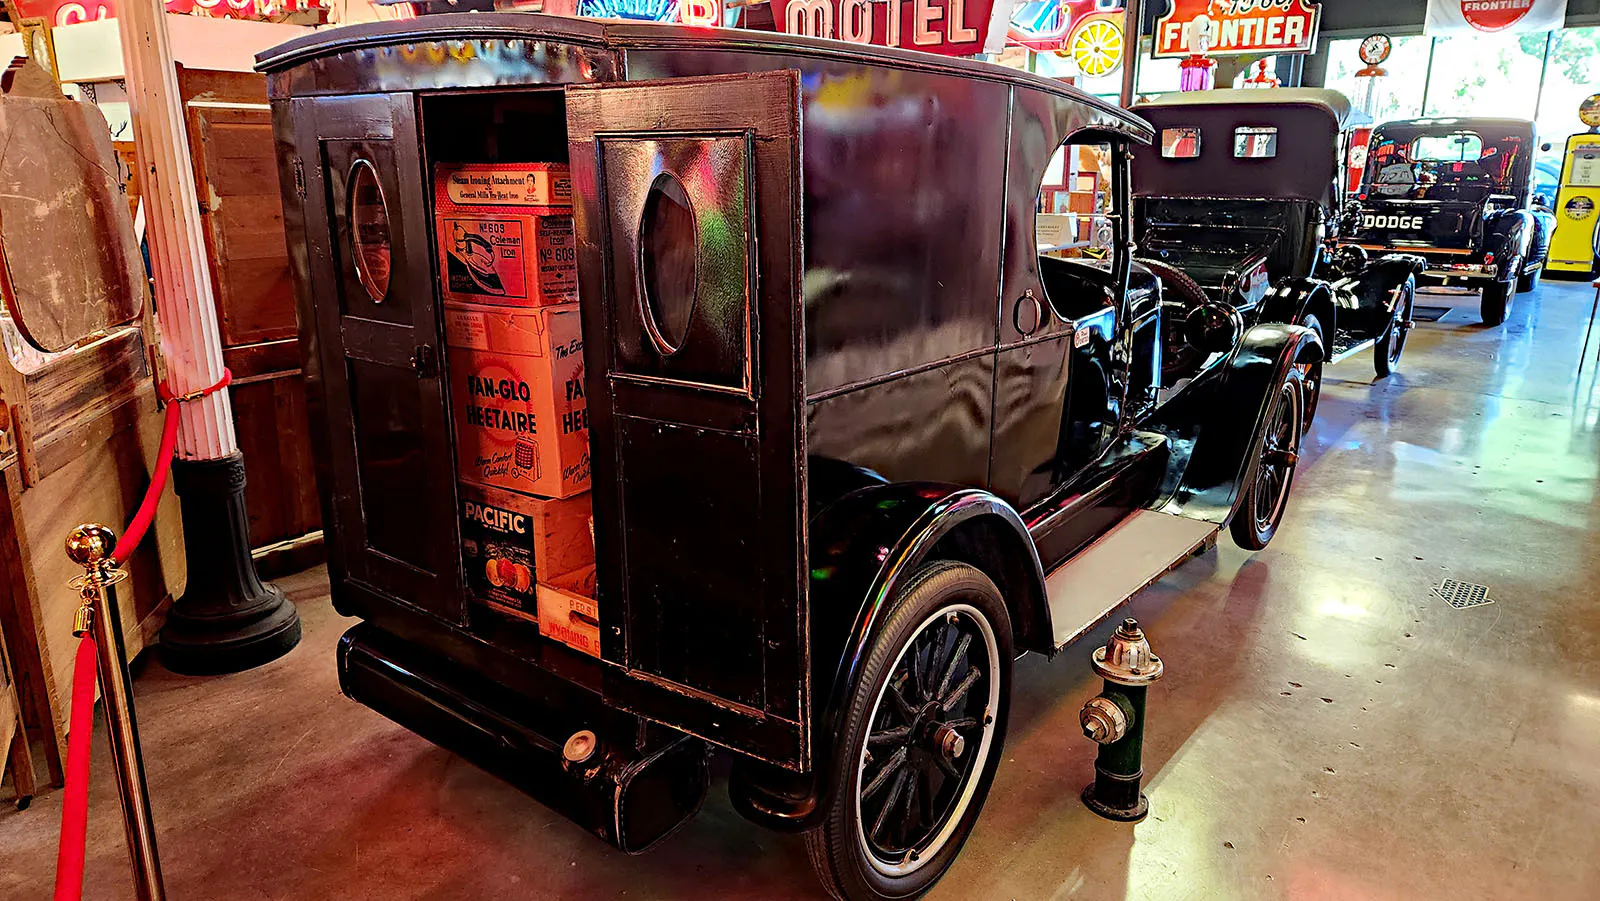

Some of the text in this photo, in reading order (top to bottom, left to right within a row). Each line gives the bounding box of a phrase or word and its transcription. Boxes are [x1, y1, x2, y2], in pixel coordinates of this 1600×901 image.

[1464, 0, 1530, 12] FRONTIER
[786, 0, 978, 47] MOTEL
[452, 175, 525, 185] Steam Ironing Attachment
[460, 191, 476, 199] General
[488, 223, 505, 234] 609
[1363, 214, 1423, 230] DODGE
[490, 235, 520, 246] Coleman
[501, 247, 516, 258] Iron
[555, 247, 575, 262] 609
[555, 345, 569, 360] The
[467, 375, 531, 402] FAN-GLO
[565, 378, 586, 401] FA
[466, 405, 537, 434] HEETAIRE
[465, 502, 525, 534] PACIFIC
[548, 621, 590, 649] WYOMING
